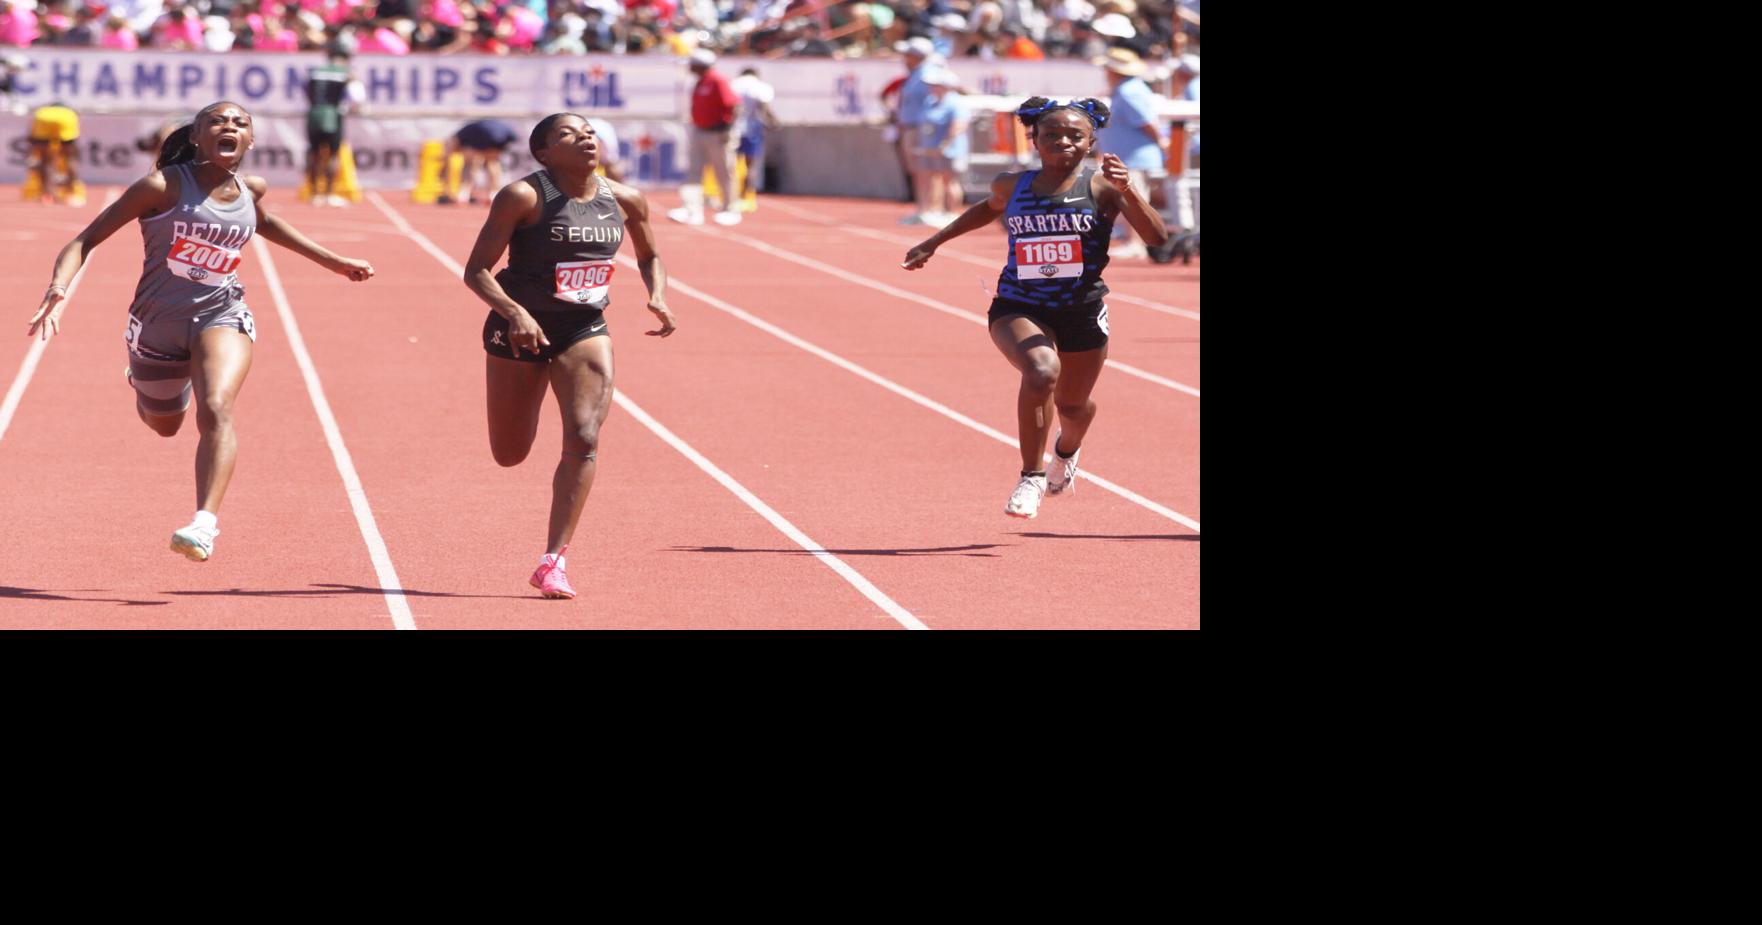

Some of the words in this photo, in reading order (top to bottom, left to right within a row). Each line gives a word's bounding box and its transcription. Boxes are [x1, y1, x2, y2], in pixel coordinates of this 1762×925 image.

[10, 63, 500, 102] CHAMPIONHIPS
[551, 226, 621, 242] SEGUIN
[1008, 213, 1093, 235] SPARTANS
[176, 242, 237, 272] 2001
[1023, 242, 1073, 263] 1169
[559, 266, 610, 289] 2096
